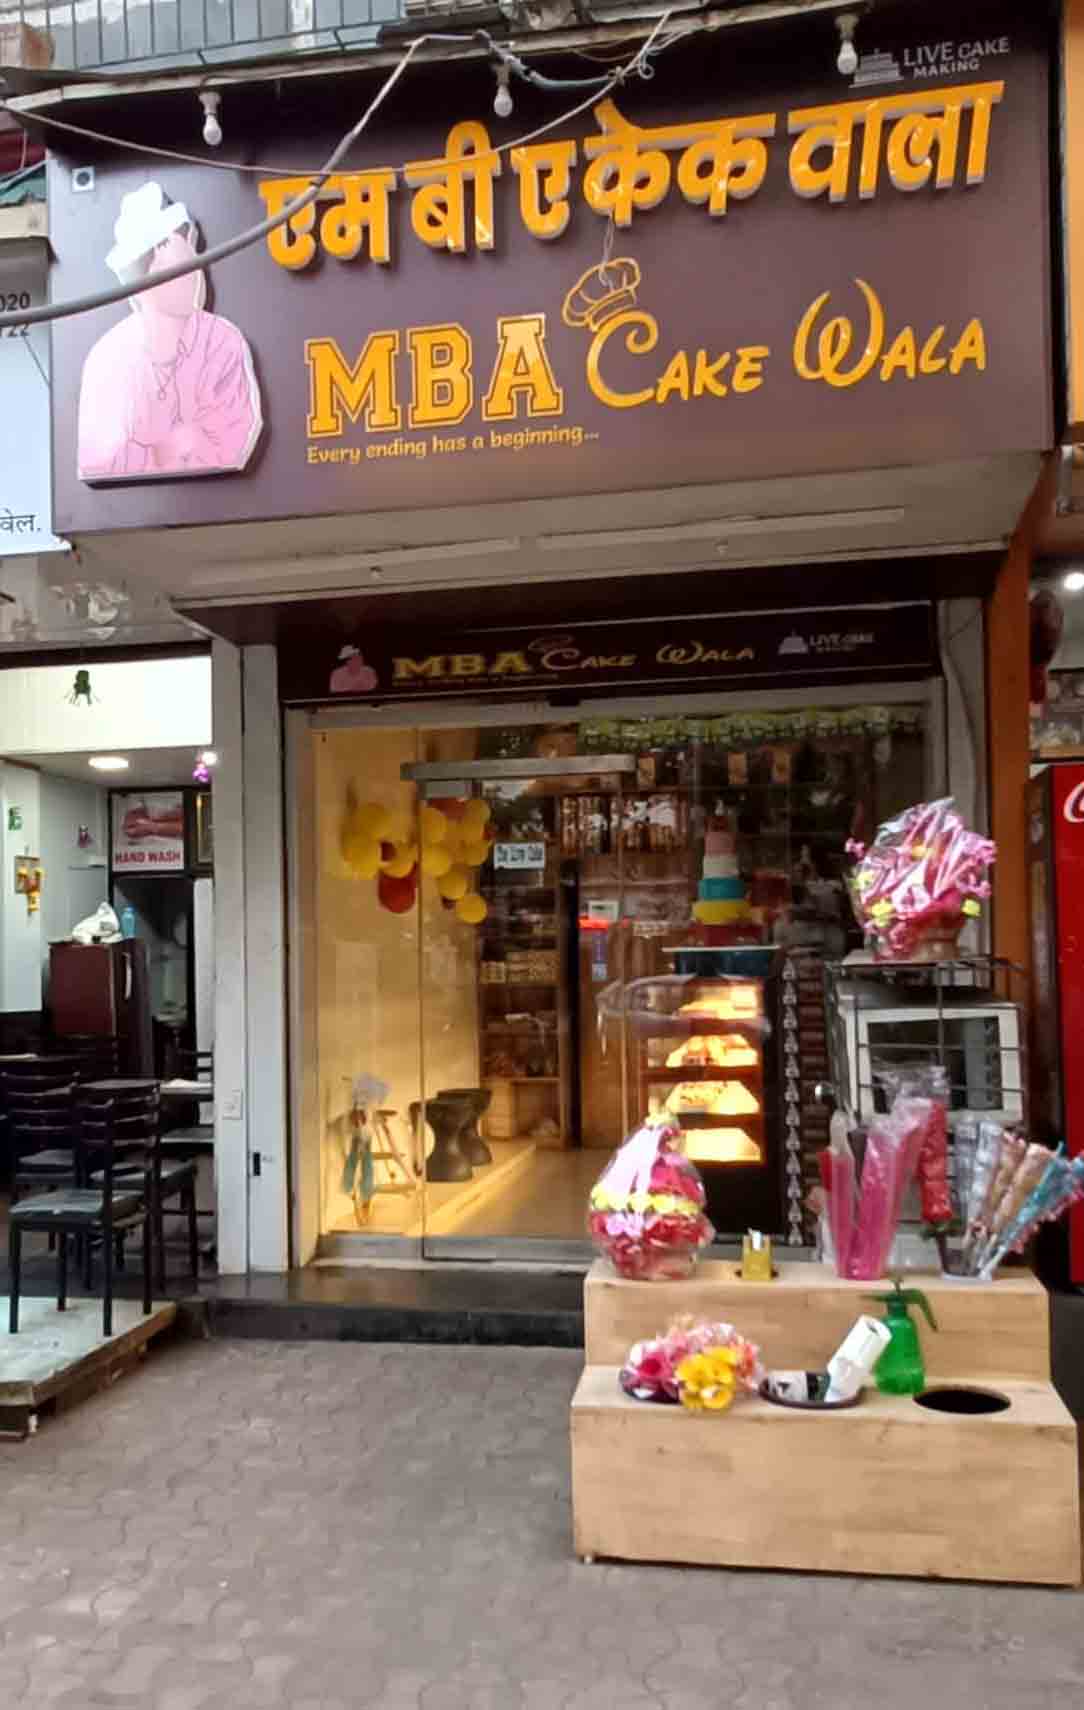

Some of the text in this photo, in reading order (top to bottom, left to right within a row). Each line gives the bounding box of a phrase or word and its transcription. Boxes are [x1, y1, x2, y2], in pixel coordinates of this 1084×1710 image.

[903, 37, 1010, 67] LIVE CAKE
[913, 58, 981, 79] MAKING
[258, 80, 1006, 271] एम बी ए केक वाला
[304, 312, 564, 438] MBA
[307, 446, 360, 464] Every
[366, 437, 426, 458] ending
[432, 434, 466, 451] has
[472, 436, 484, 449] a
[391, 651, 533, 679] MBA
[115, 850, 181, 865] HAND WASH
